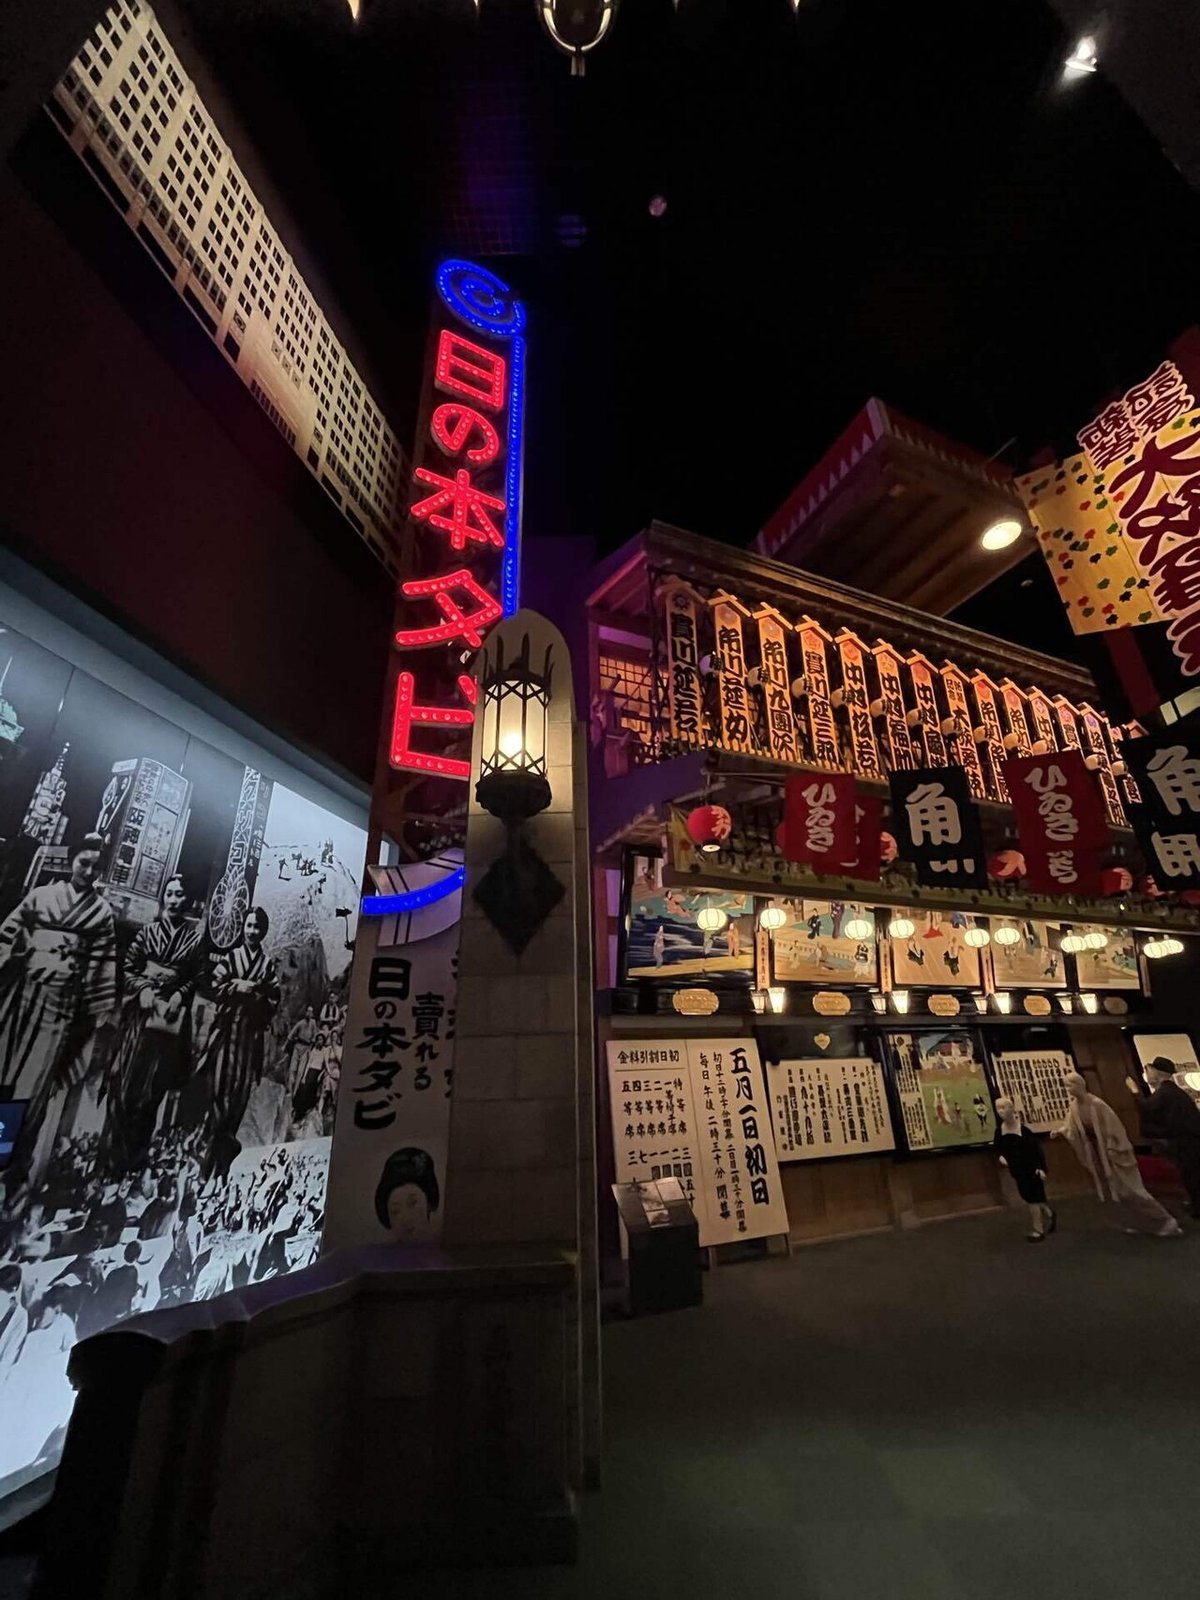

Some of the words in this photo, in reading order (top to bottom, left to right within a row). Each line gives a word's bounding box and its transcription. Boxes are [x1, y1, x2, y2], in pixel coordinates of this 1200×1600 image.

[353, 957, 412, 1130] 日の本タビ
[729, 1047, 770, 1205] 五月一日初日
